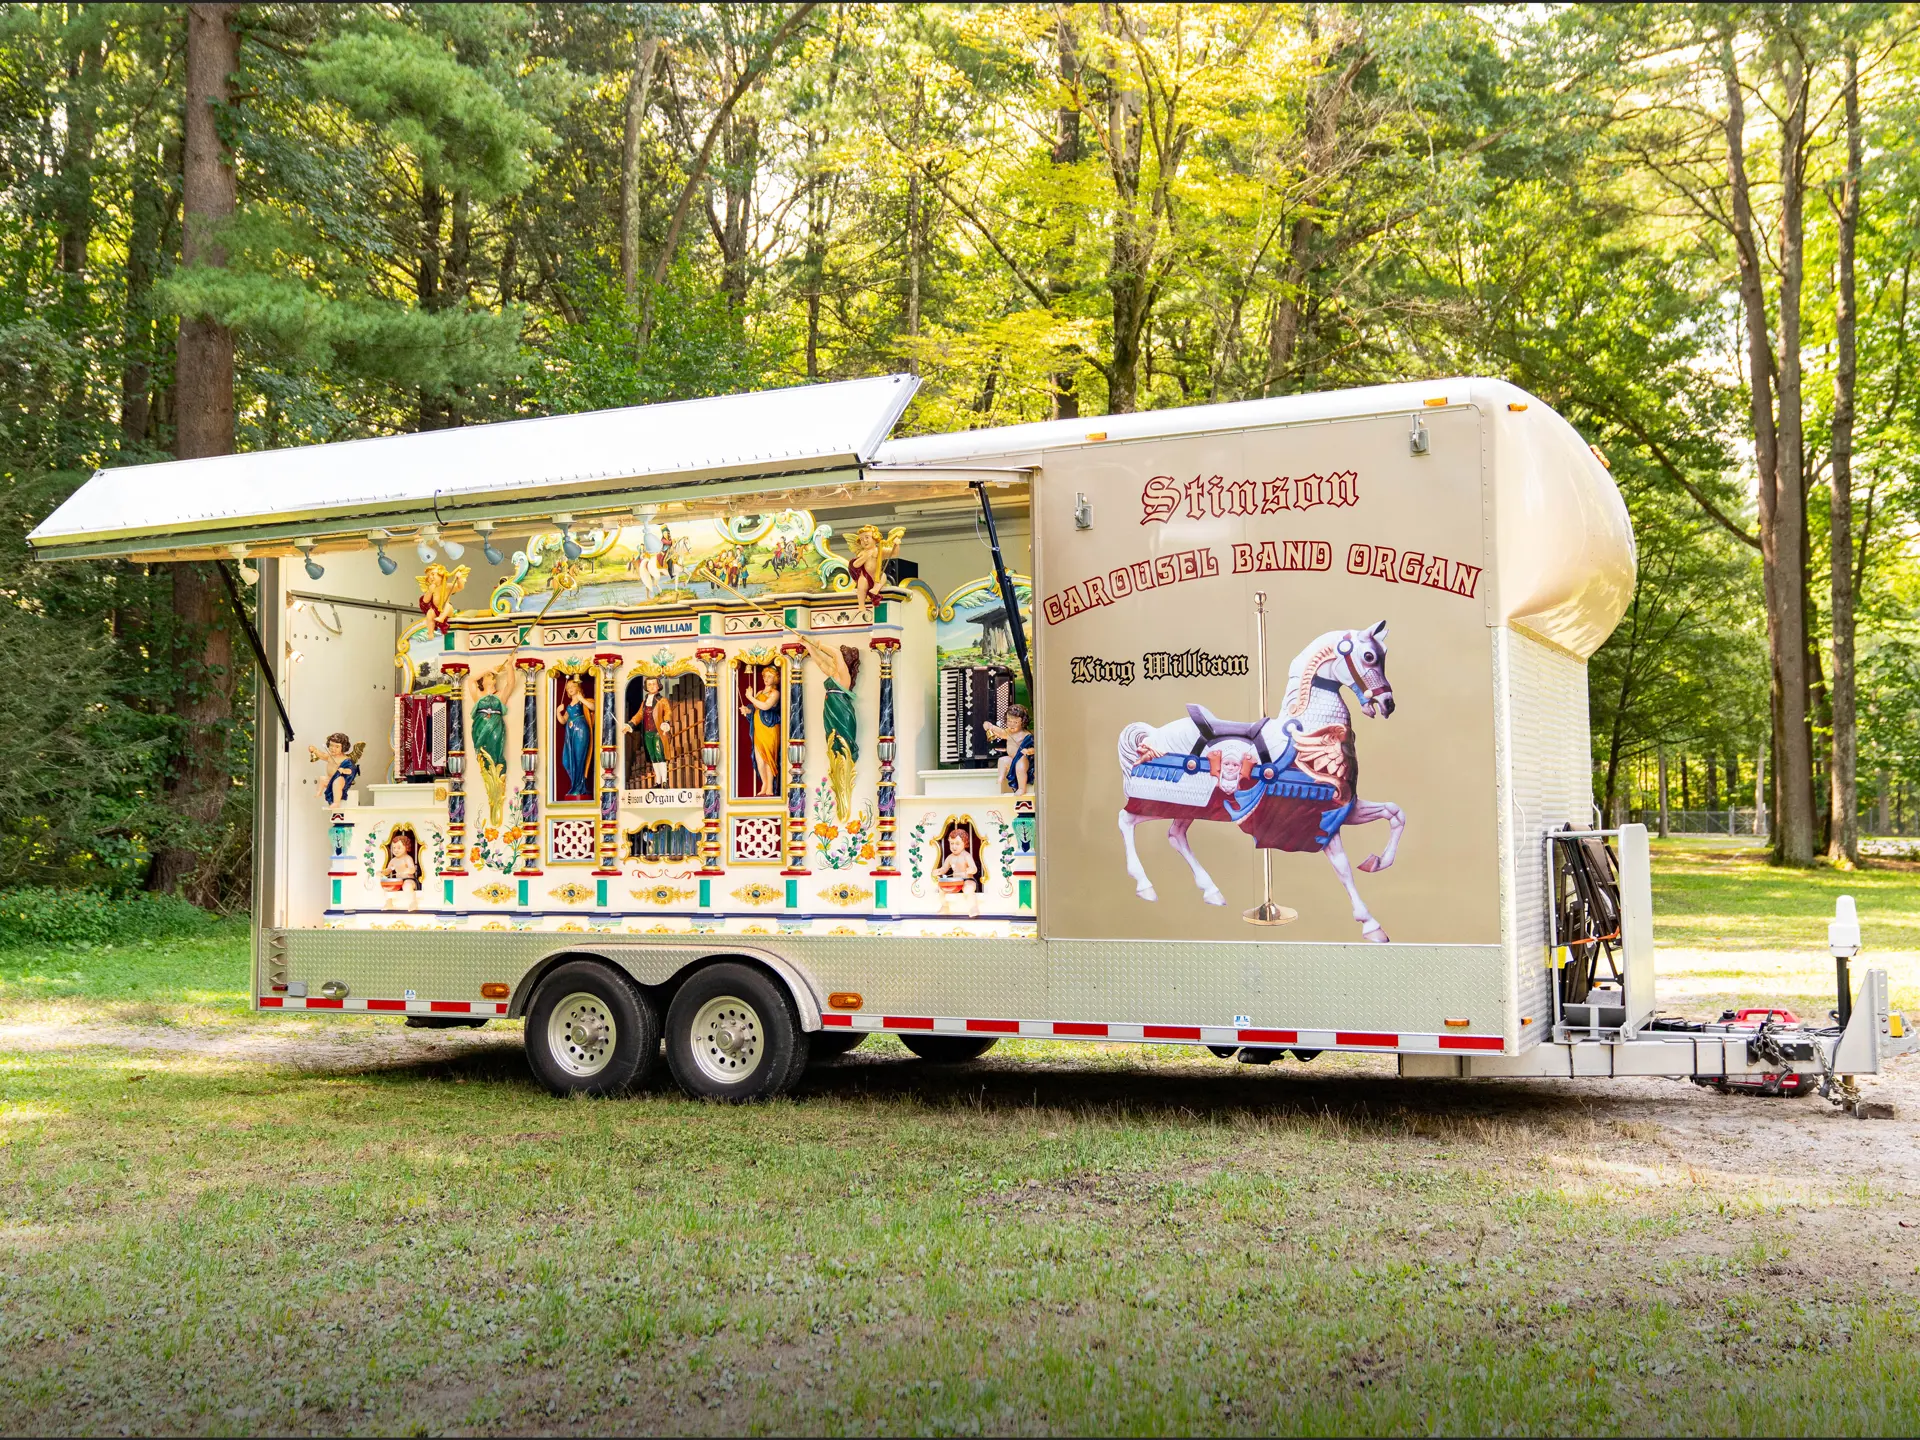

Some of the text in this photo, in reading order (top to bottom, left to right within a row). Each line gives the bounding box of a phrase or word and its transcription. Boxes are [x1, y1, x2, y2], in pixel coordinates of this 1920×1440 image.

[1140, 469, 1360, 525] Stinson
[1043, 540, 1483, 626] CAROUSEL BAND ORGAN
[629, 622, 692, 635] KING WILLIAM
[1070, 647, 1249, 687] King William
[644, 790, 674, 804] Organ
